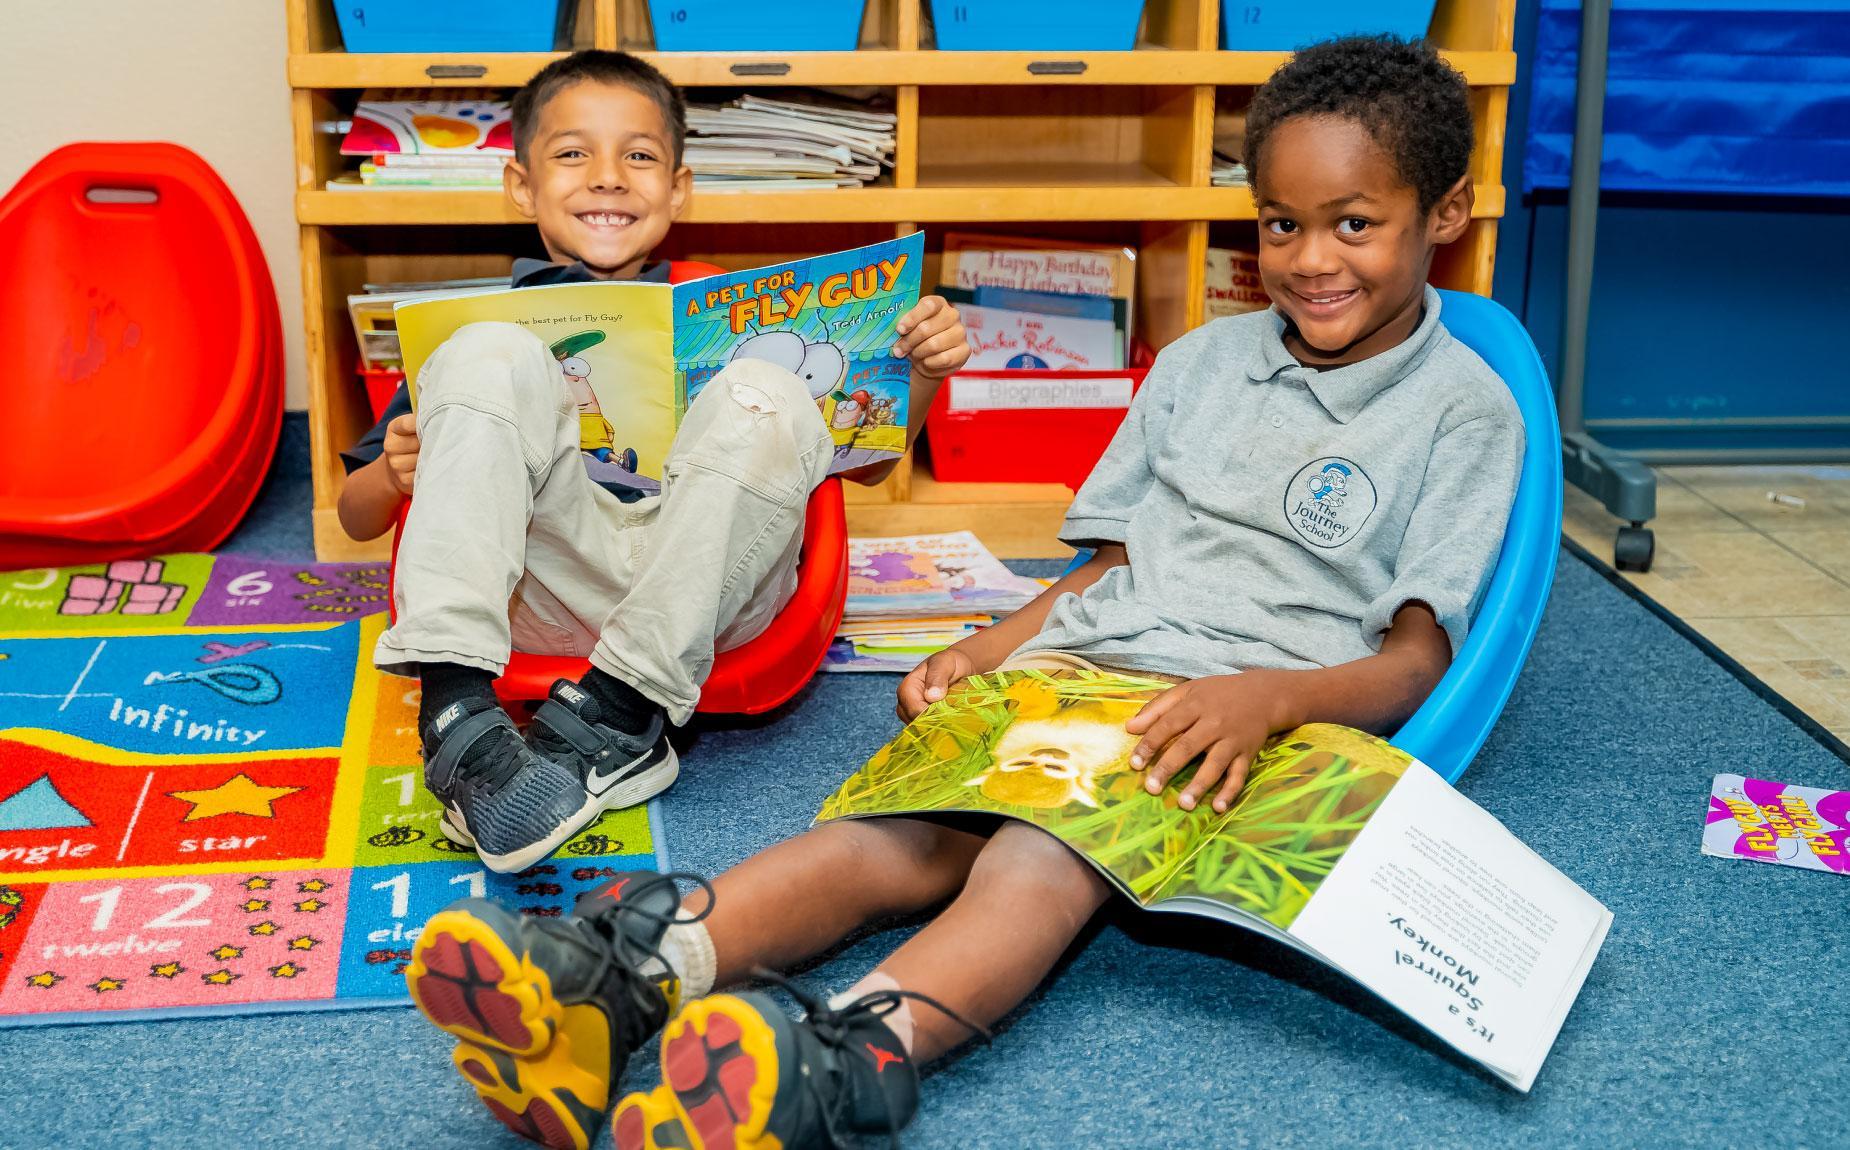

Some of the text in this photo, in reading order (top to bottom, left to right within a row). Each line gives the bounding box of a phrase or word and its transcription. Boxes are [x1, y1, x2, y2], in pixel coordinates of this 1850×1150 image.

[353, 8, 366, 28] 9
[670, 10, 687, 23] 10
[953, 7, 967, 23] 11
[1243, 6, 1261, 24] 12
[988, 251, 1110, 278] Happy Birthday
[687, 270, 798, 317] A PET FOR
[730, 254, 909, 334] FLY GUY
[532, 317, 550, 325] best
[553, 316, 566, 325] pet
[585, 314, 598, 322] Fly
[601, 313, 623, 322] Guy?
[833, 300, 906, 331] Tedd Arnold
[971, 330, 1018, 355] Jackie
[852, 363, 910, 385] PET SHO
[989, 382, 1102, 402] Biographies
[1292, 501, 1350, 537] Journey
[1318, 502, 1337, 518] The
[1299, 519, 1335, 541] School
[226, 570, 273, 596] 6
[557, 684, 586, 705] NIKE
[108, 697, 267, 746] Infinity
[435, 703, 461, 733] NIKE
[1723, 797, 1780, 852] FLY GUY
[1758, 804, 1801, 839] MEETS
[178, 834, 268, 853] star
[1799, 829, 1841, 856] FLY
[80, 881, 214, 932] 12
[41, 934, 184, 960] twelve
[1388, 912, 1480, 986] Monkey.
[1395, 949, 1484, 1012] Squirrel
[1447, 1004, 1496, 1043] It's a
